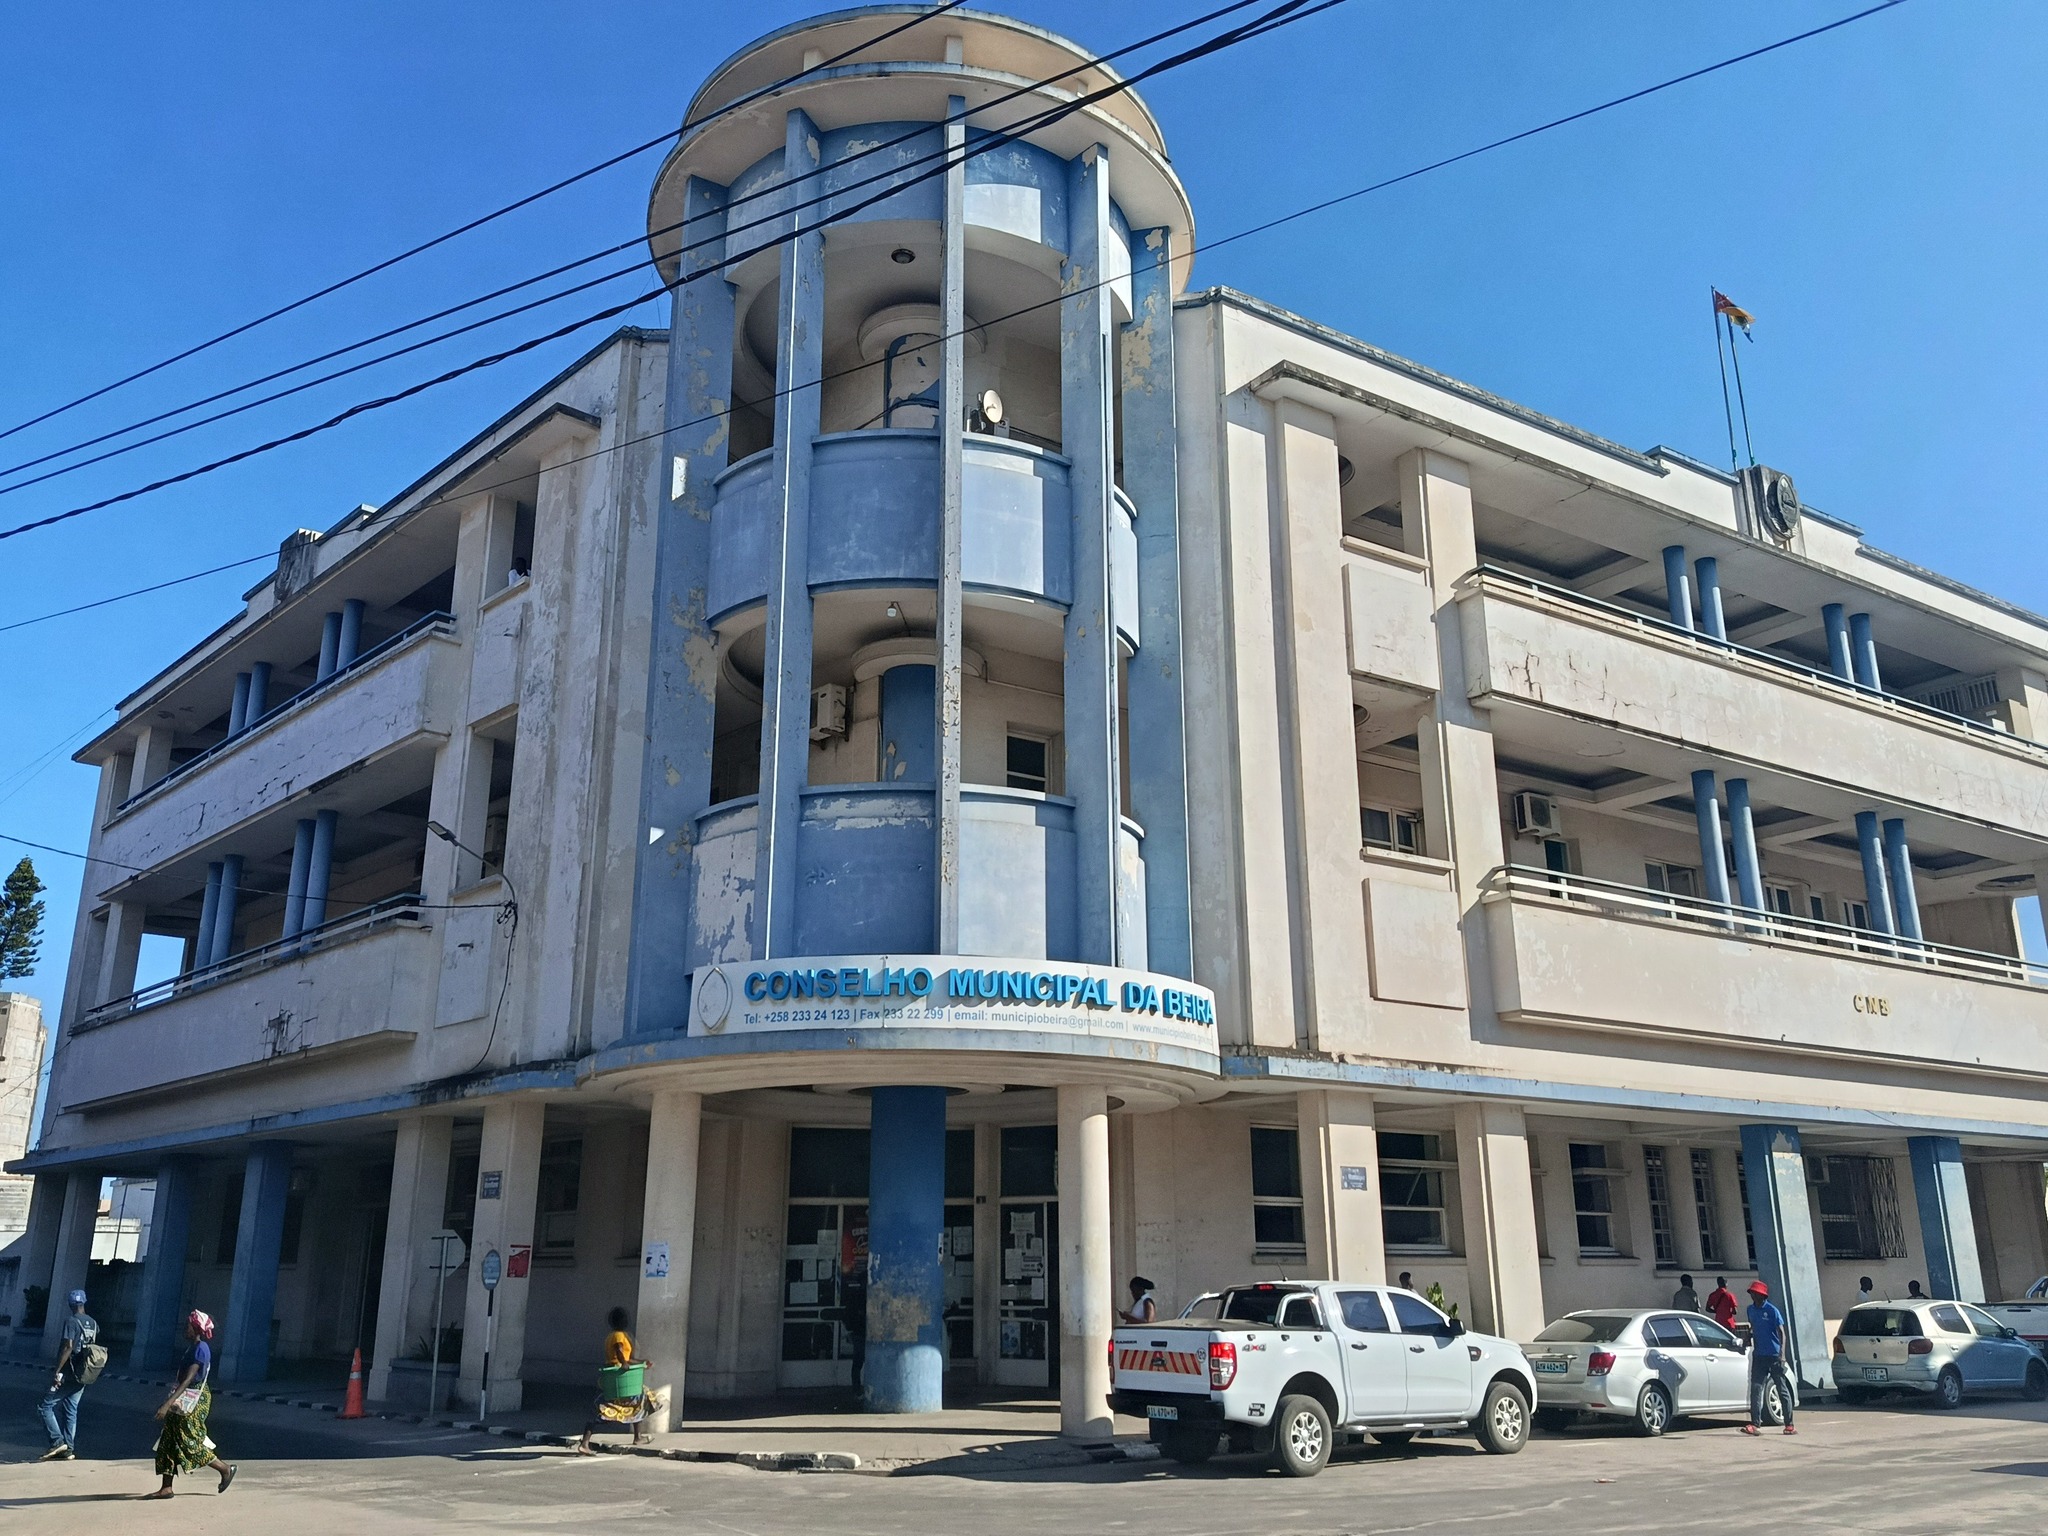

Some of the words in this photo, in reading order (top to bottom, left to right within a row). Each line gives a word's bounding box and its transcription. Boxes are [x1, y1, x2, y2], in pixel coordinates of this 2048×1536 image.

[744, 967, 934, 1002] CONSELHO
[949, 968, 1118, 1006] MUNICIPAL
[1124, 981, 1161, 1013] DA
[1163, 988, 1214, 1025] BEIRA
[744, 1013, 761, 1025] Tel:
[764, 1011, 789, 1023] +258
[792, 1010, 811, 1021] 233
[814, 1009, 827, 1021] 24
[831, 1009, 850, 1020] 123
[860, 1009, 880, 1020] Fax
[884, 1008, 904, 1020] 233
[907, 1009, 920, 1019] 22
[924, 1009, 944, 1020] 299
[954, 1009, 988, 1021] email:
